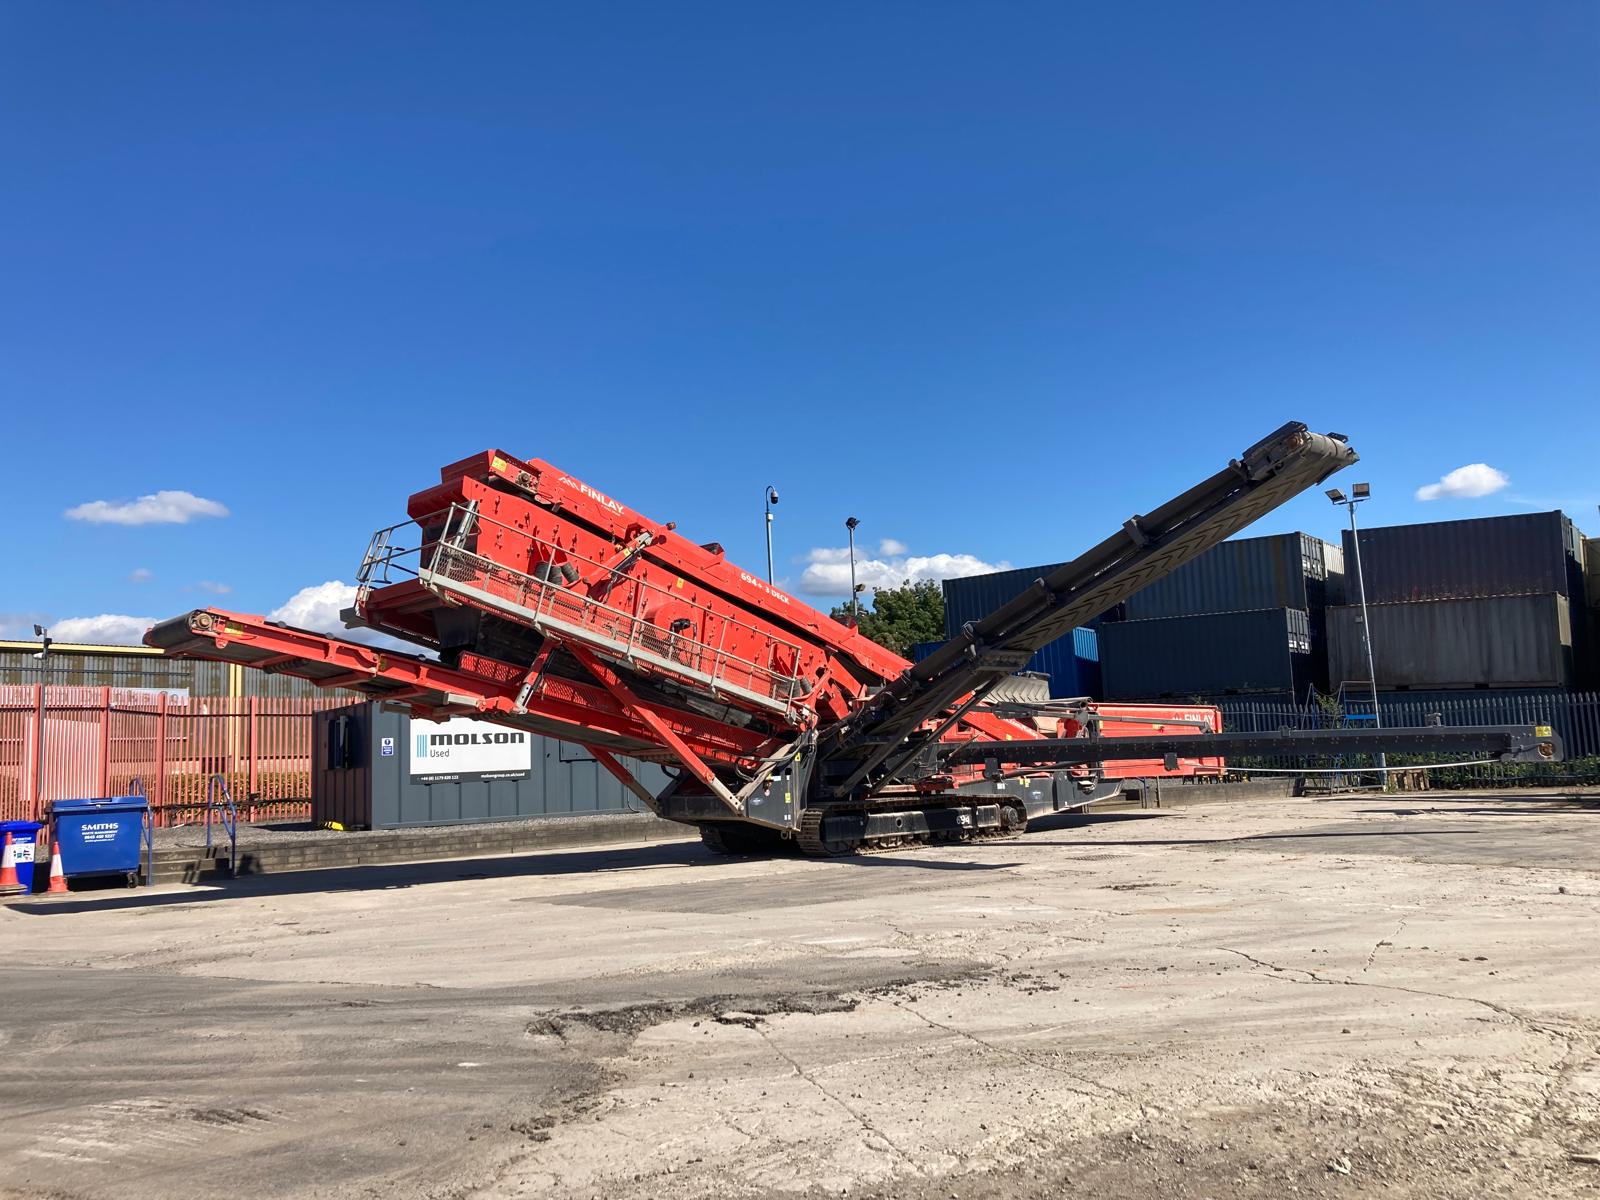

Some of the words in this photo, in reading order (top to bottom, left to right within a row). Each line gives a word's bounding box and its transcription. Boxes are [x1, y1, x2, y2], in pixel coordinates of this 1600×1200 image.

[580, 483, 624, 513] FINLAY
[771, 589, 790, 605] DECK
[429, 749, 450, 758] Used
[956, 814, 970, 825] 694
[81, 822, 119, 831] SMITHS
